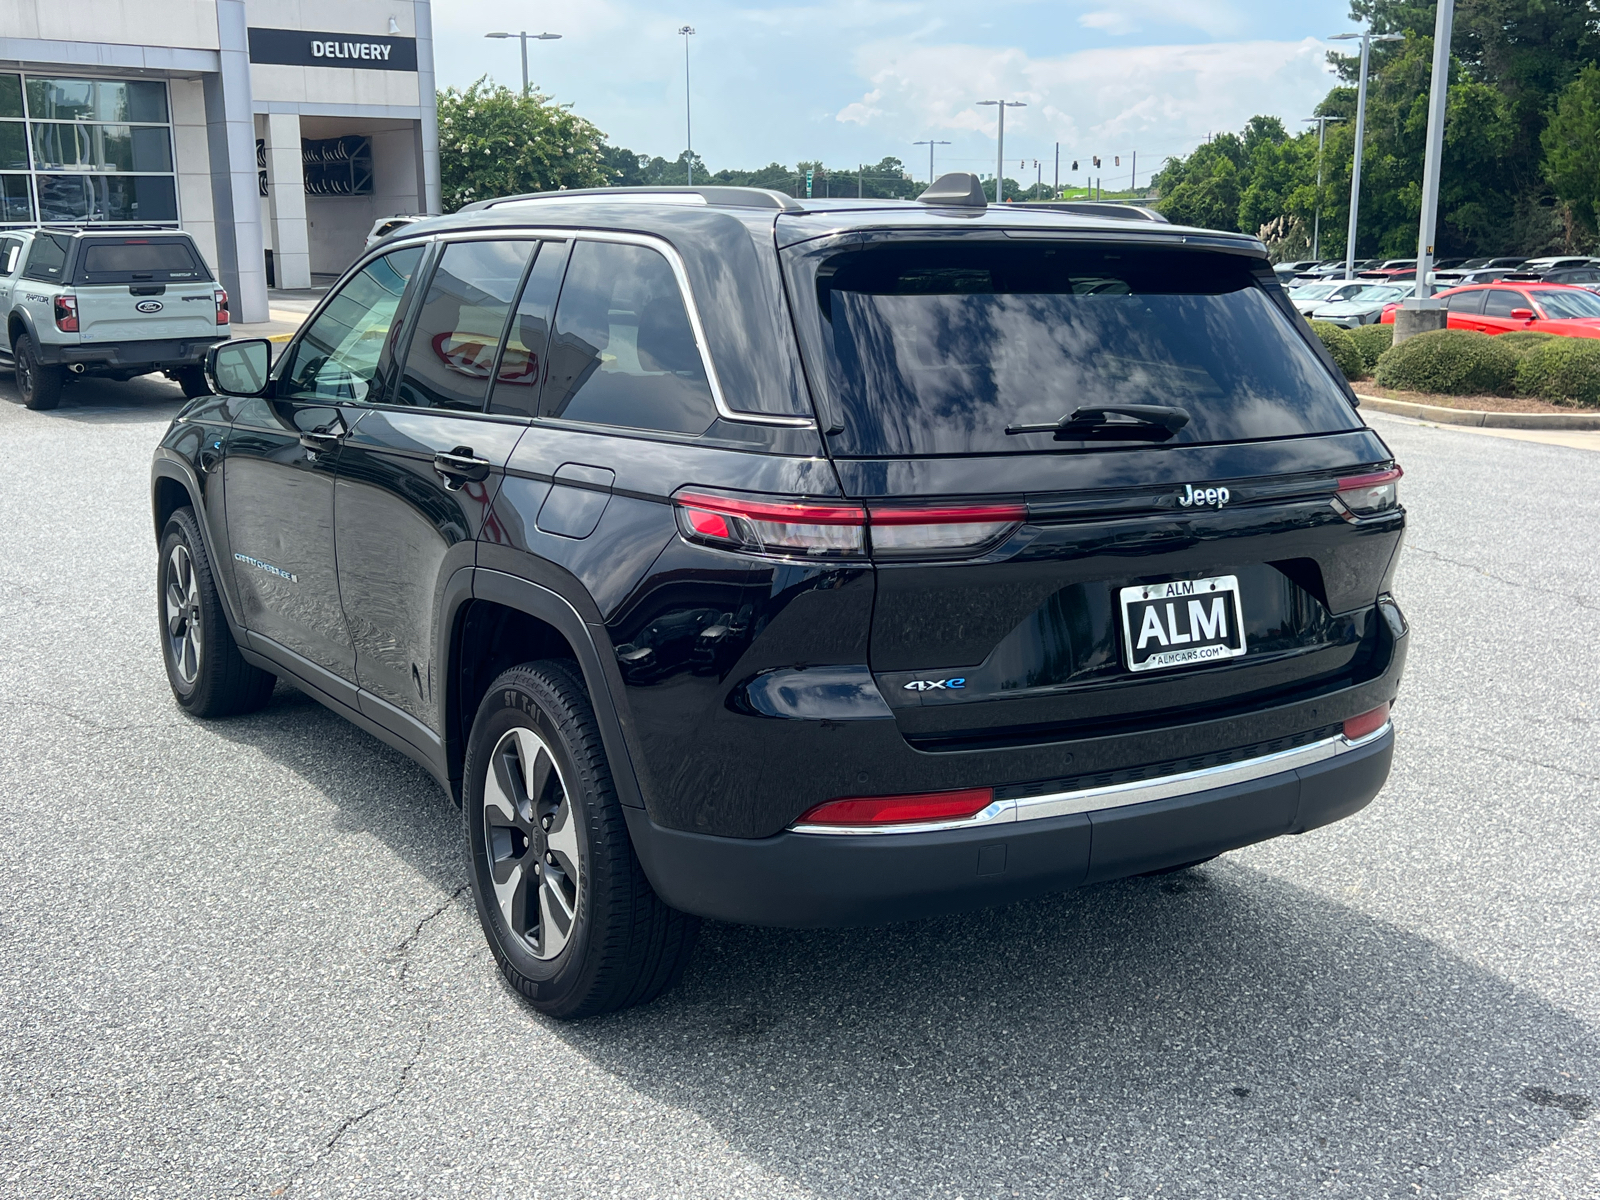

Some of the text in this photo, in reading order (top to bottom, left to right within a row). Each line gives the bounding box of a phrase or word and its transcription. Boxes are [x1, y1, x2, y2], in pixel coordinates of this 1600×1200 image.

[311, 40, 391, 60] DELIVERY
[25, 293, 50, 305] RAPTOR
[1179, 484, 1230, 509] Jeep
[1166, 581, 1195, 597] ALM
[1136, 597, 1228, 650] ALM
[1157, 649, 1219, 666] ALMCARS.COM
